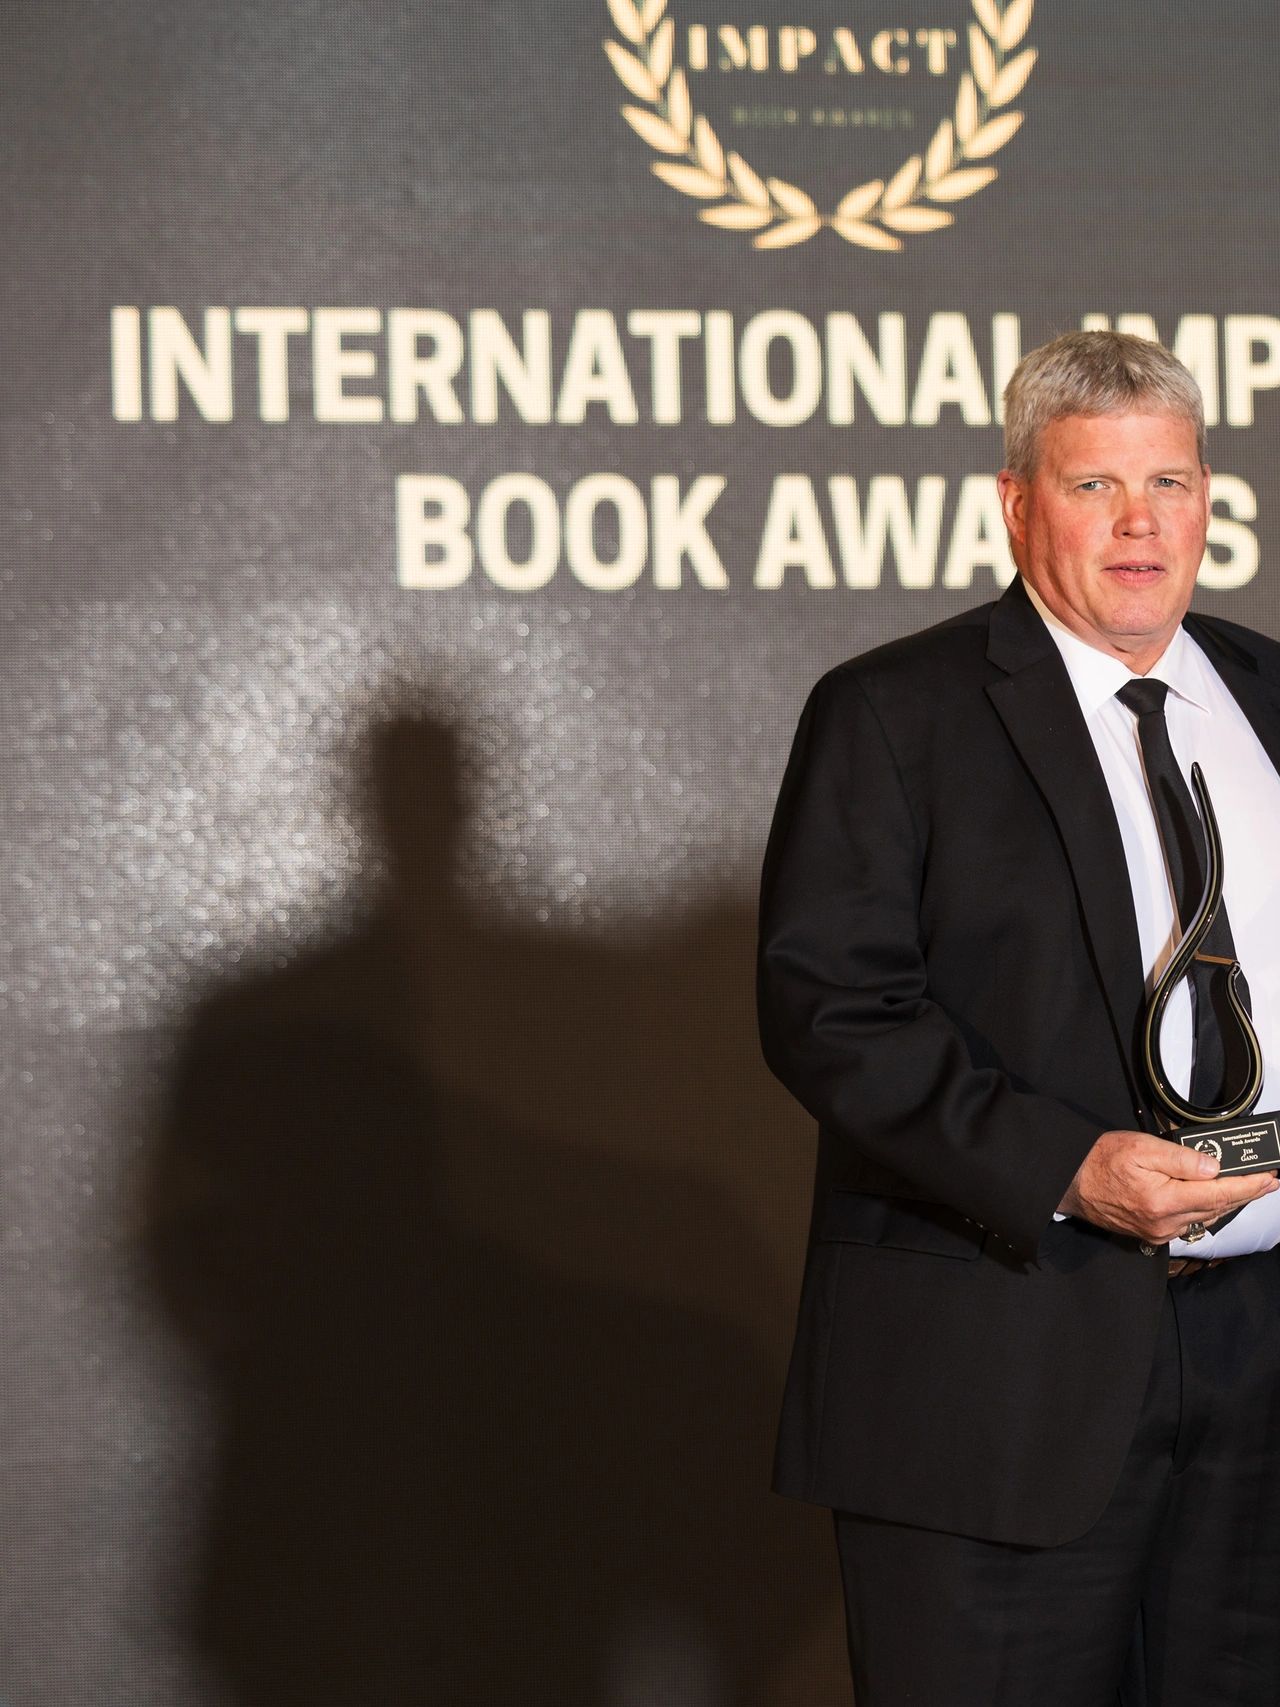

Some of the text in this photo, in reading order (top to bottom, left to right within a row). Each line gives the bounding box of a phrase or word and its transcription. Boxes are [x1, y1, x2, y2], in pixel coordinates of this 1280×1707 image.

[688, 23, 957, 75] IMPACT
[110, 305, 1021, 427] INTERNATIONAL
[395, 472, 1260, 591] BOOK AWAS
